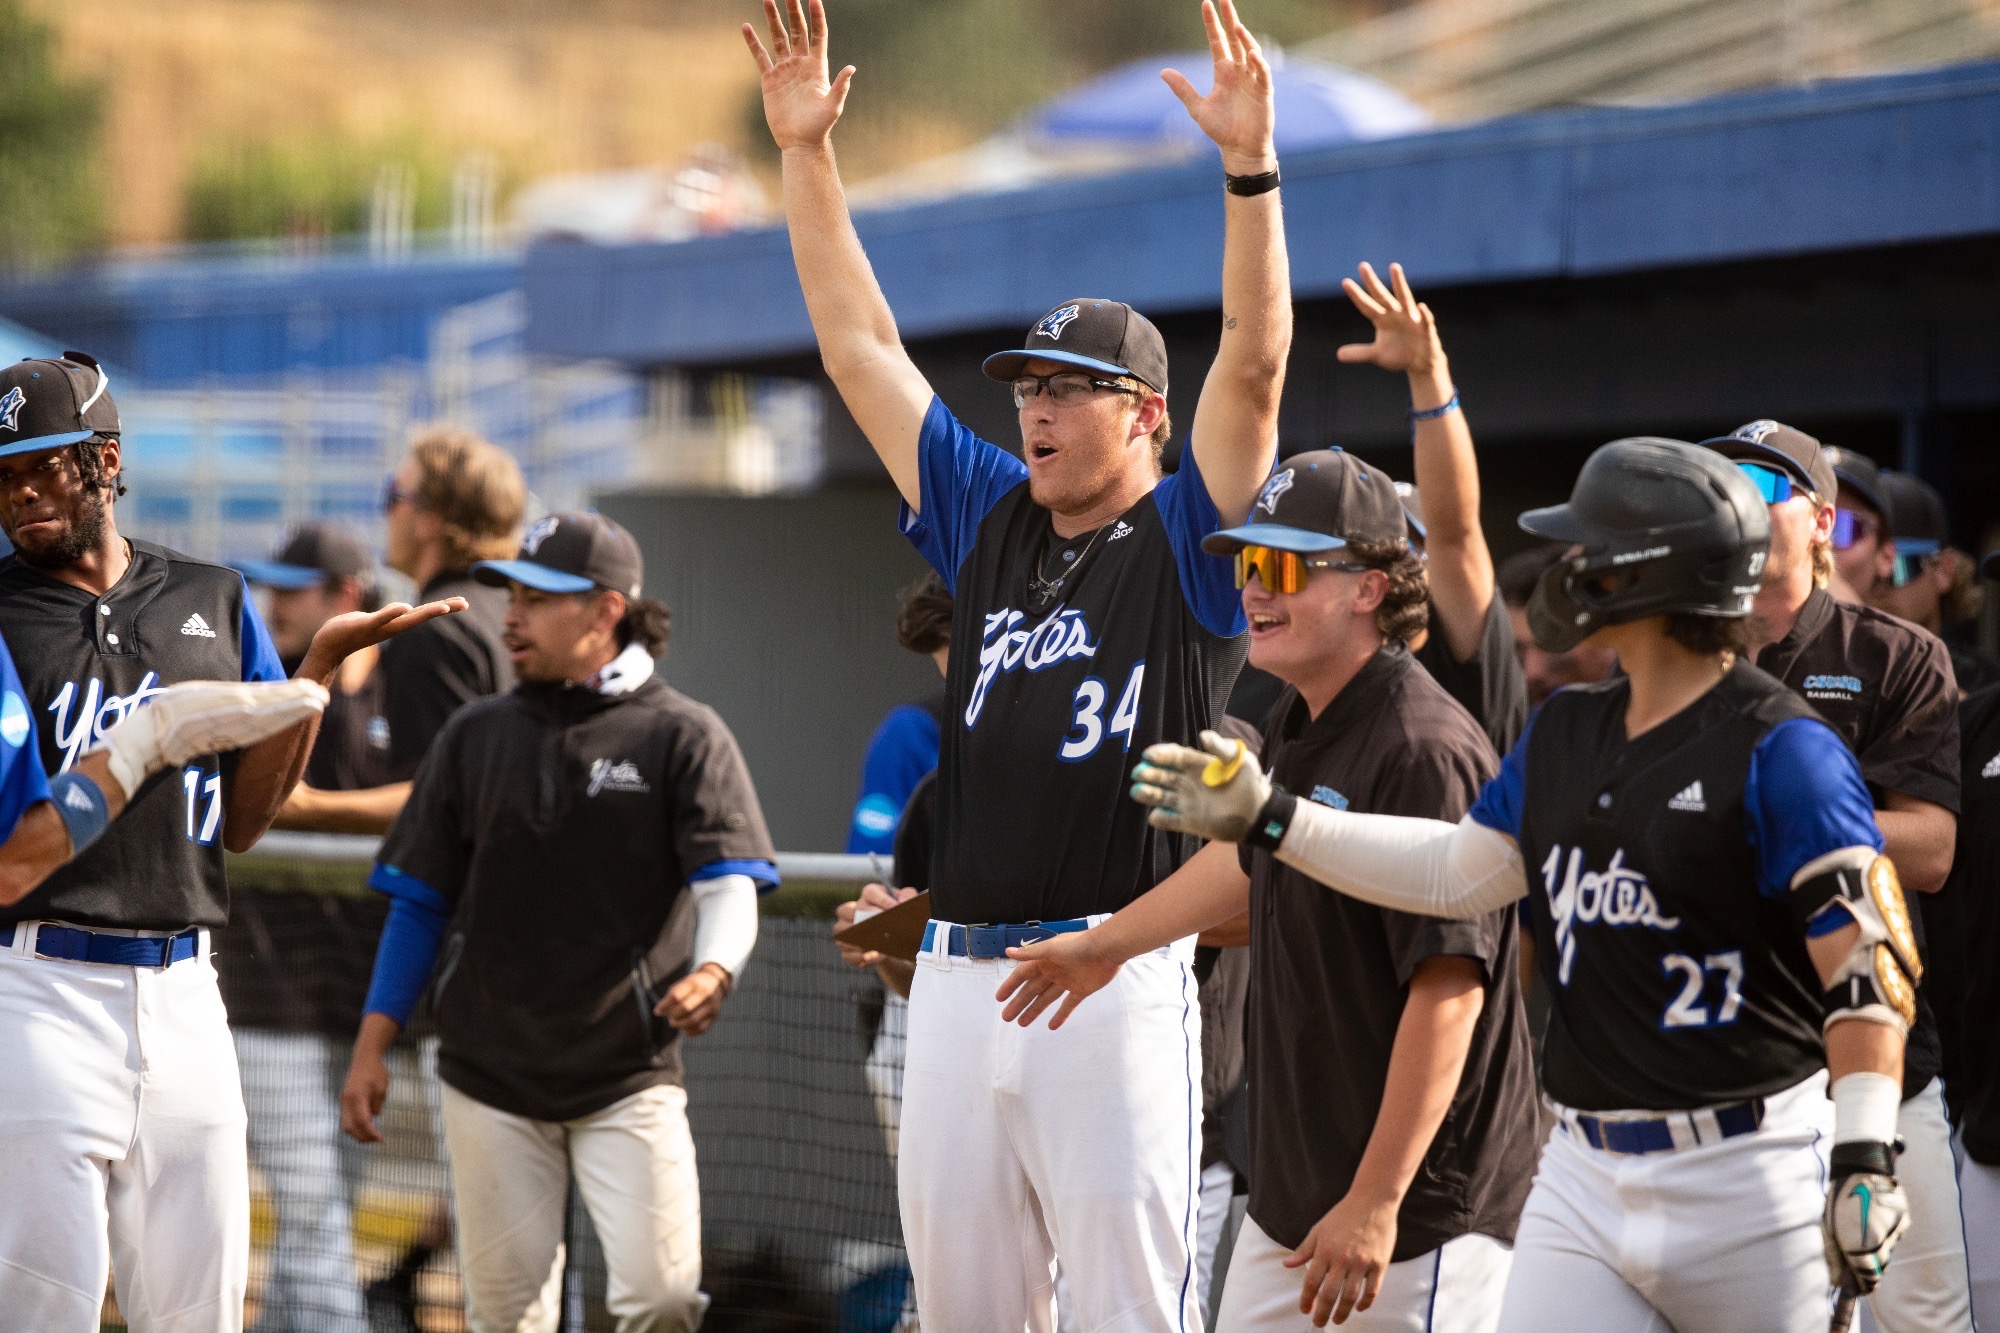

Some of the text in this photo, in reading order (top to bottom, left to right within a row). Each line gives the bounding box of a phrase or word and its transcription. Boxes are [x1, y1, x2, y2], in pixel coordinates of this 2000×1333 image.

[180, 627, 216, 638] adidas
[965, 601, 1100, 731] Yotes
[48, 671, 169, 775] Yot
[1057, 659, 1146, 763] 34
[1807, 690, 1852, 700] BASEBALL
[183, 766, 222, 846] 17
[1541, 843, 1681, 986] Yotes
[1661, 950, 1744, 1028] 27
